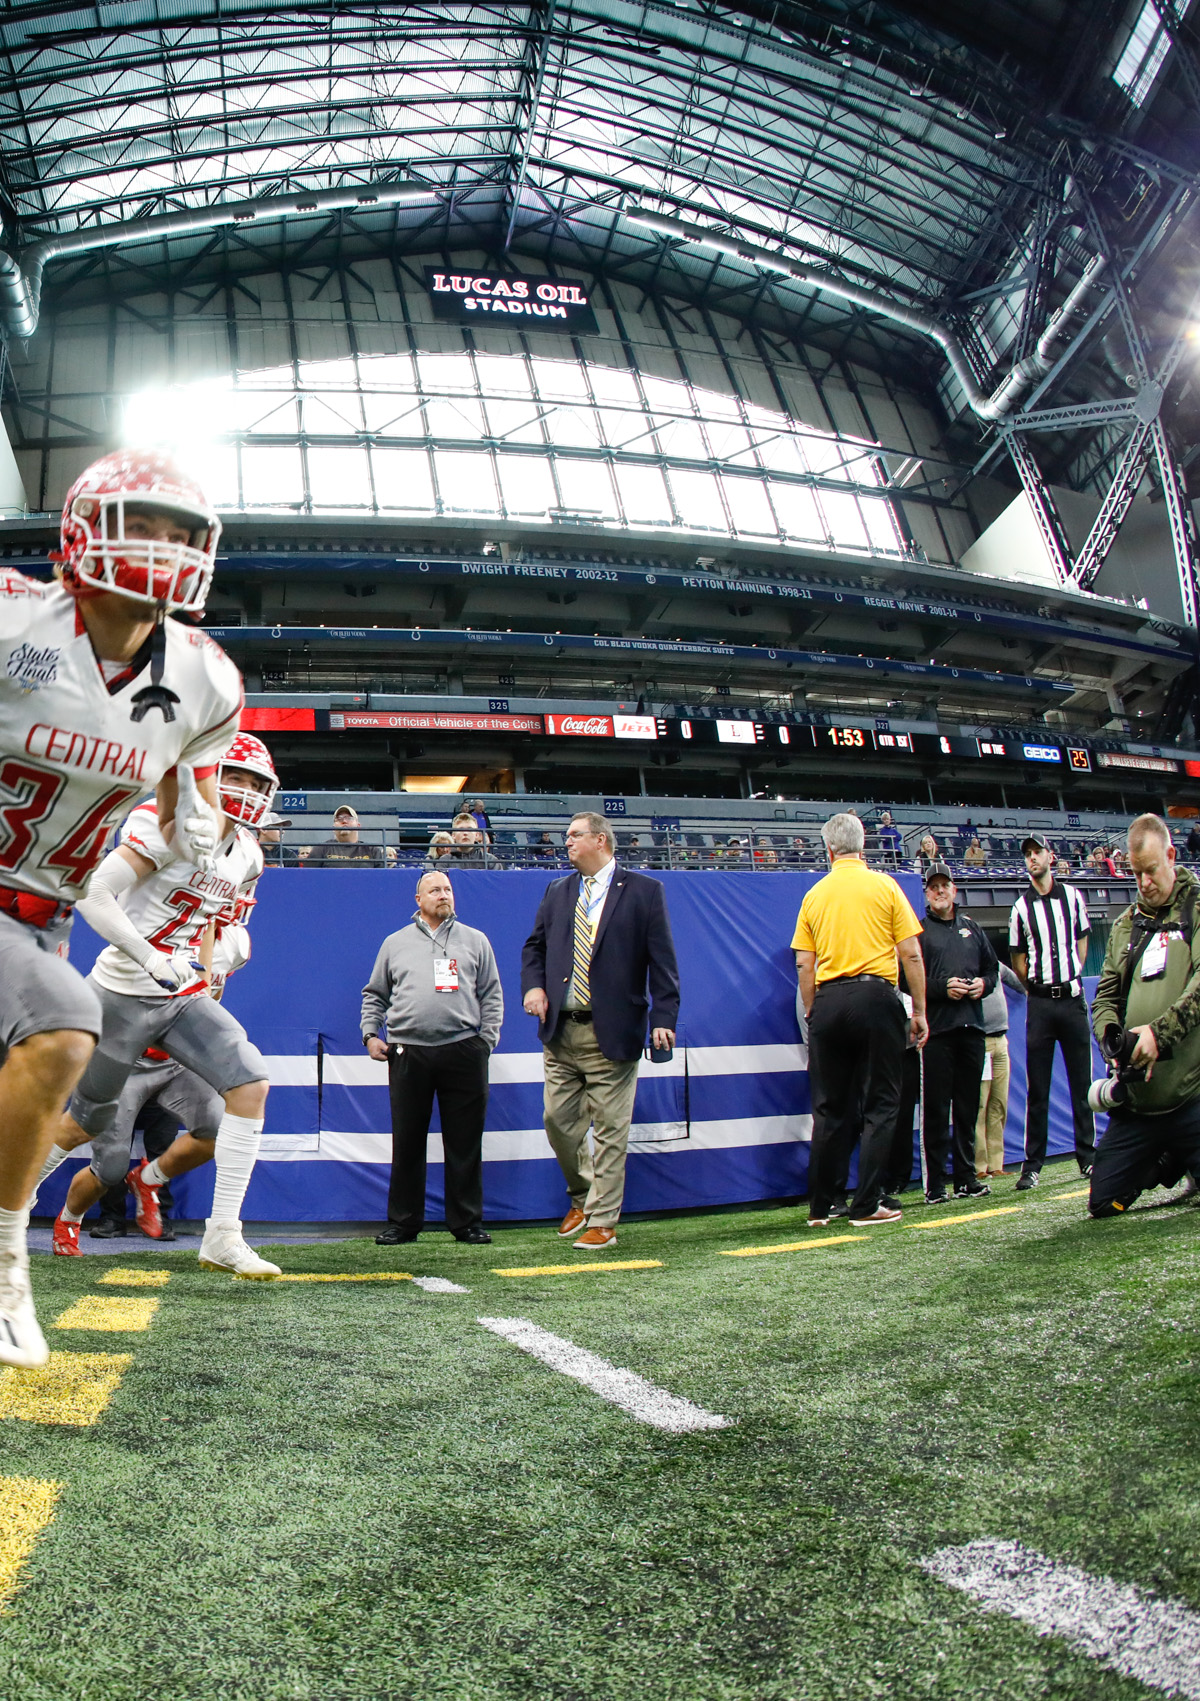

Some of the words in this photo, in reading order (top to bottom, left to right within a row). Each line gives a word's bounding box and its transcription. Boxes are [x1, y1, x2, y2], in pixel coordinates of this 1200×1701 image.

[433, 274, 529, 298] LUCAS
[536, 284, 587, 305] OIL
[463, 297, 568, 319] STADIUM
[462, 563, 509, 576] DWIGHT
[515, 566, 568, 579] FREENEY
[576, 569, 619, 582] 2002-12
[682, 576, 725, 590] PEYTON
[727, 580, 773, 595] MANNING
[777, 586, 813, 600] 1998-11
[864, 596, 896, 610] REGGIE
[897, 601, 926, 614] WAYNE
[928, 605, 958, 619] 2001-14
[9, 642, 62, 662] State
[594, 639, 609, 648] COL
[610, 640, 631, 649] BLEU
[631, 641, 657, 651] VODKA
[658, 643, 711, 655] QUARTERBACK
[712, 646, 735, 656] SUITE
[7, 661, 58, 682] Finals
[490, 701, 508, 710] 325
[389, 716, 430, 727] Official
[434, 717, 473, 728] Vehicle
[477, 718, 488, 728] of
[491, 718, 510, 729] the
[512, 719, 541, 730] Colts
[560, 716, 609, 735] Coca-Cola
[616, 722, 652, 733] JETS
[680, 720, 693, 739] 0
[877, 721, 889, 730] 327
[778, 726, 791, 744] 0
[828, 727, 865, 746] 1:53
[878, 734, 895, 746] QTR
[896, 735, 909, 747] 1ST
[25, 723, 148, 782] CENTRAL
[940, 735, 951, 753] &
[1023, 746, 1061, 761] GEICO
[1072, 750, 1087, 767] 25
[284, 796, 306, 807] 224
[605, 802, 625, 811] 225
[1069, 816, 1080, 825] 228
